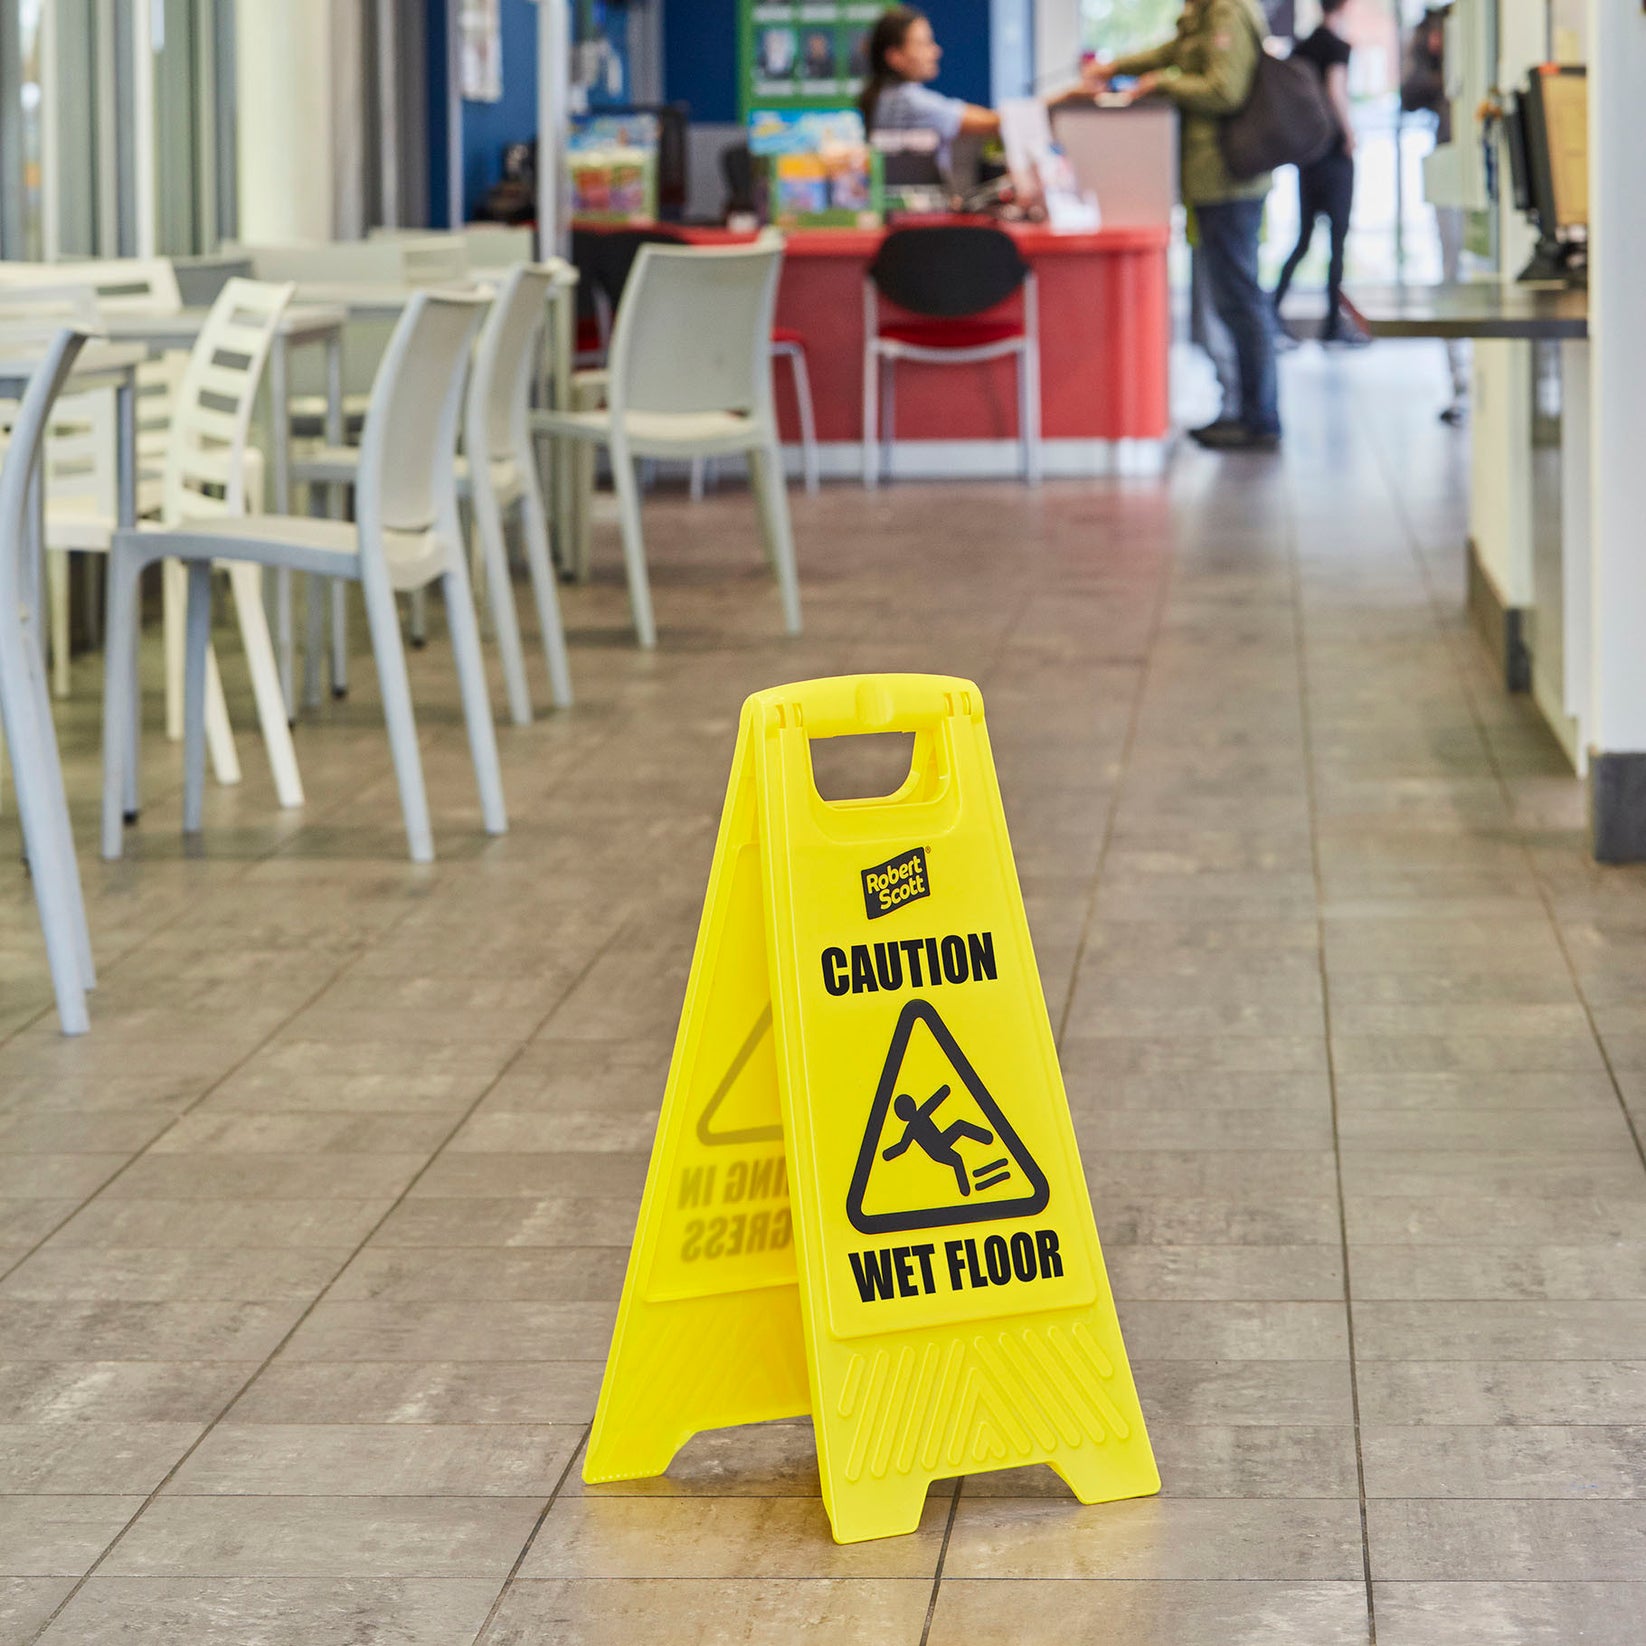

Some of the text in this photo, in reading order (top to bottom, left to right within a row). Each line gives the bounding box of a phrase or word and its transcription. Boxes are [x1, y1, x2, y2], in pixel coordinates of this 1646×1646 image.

[866, 855, 923, 894] Robert
[878, 875, 926, 910] Scott
[821, 931, 998, 996] CAUTION
[848, 1230, 1064, 1302] WET FLOOR
